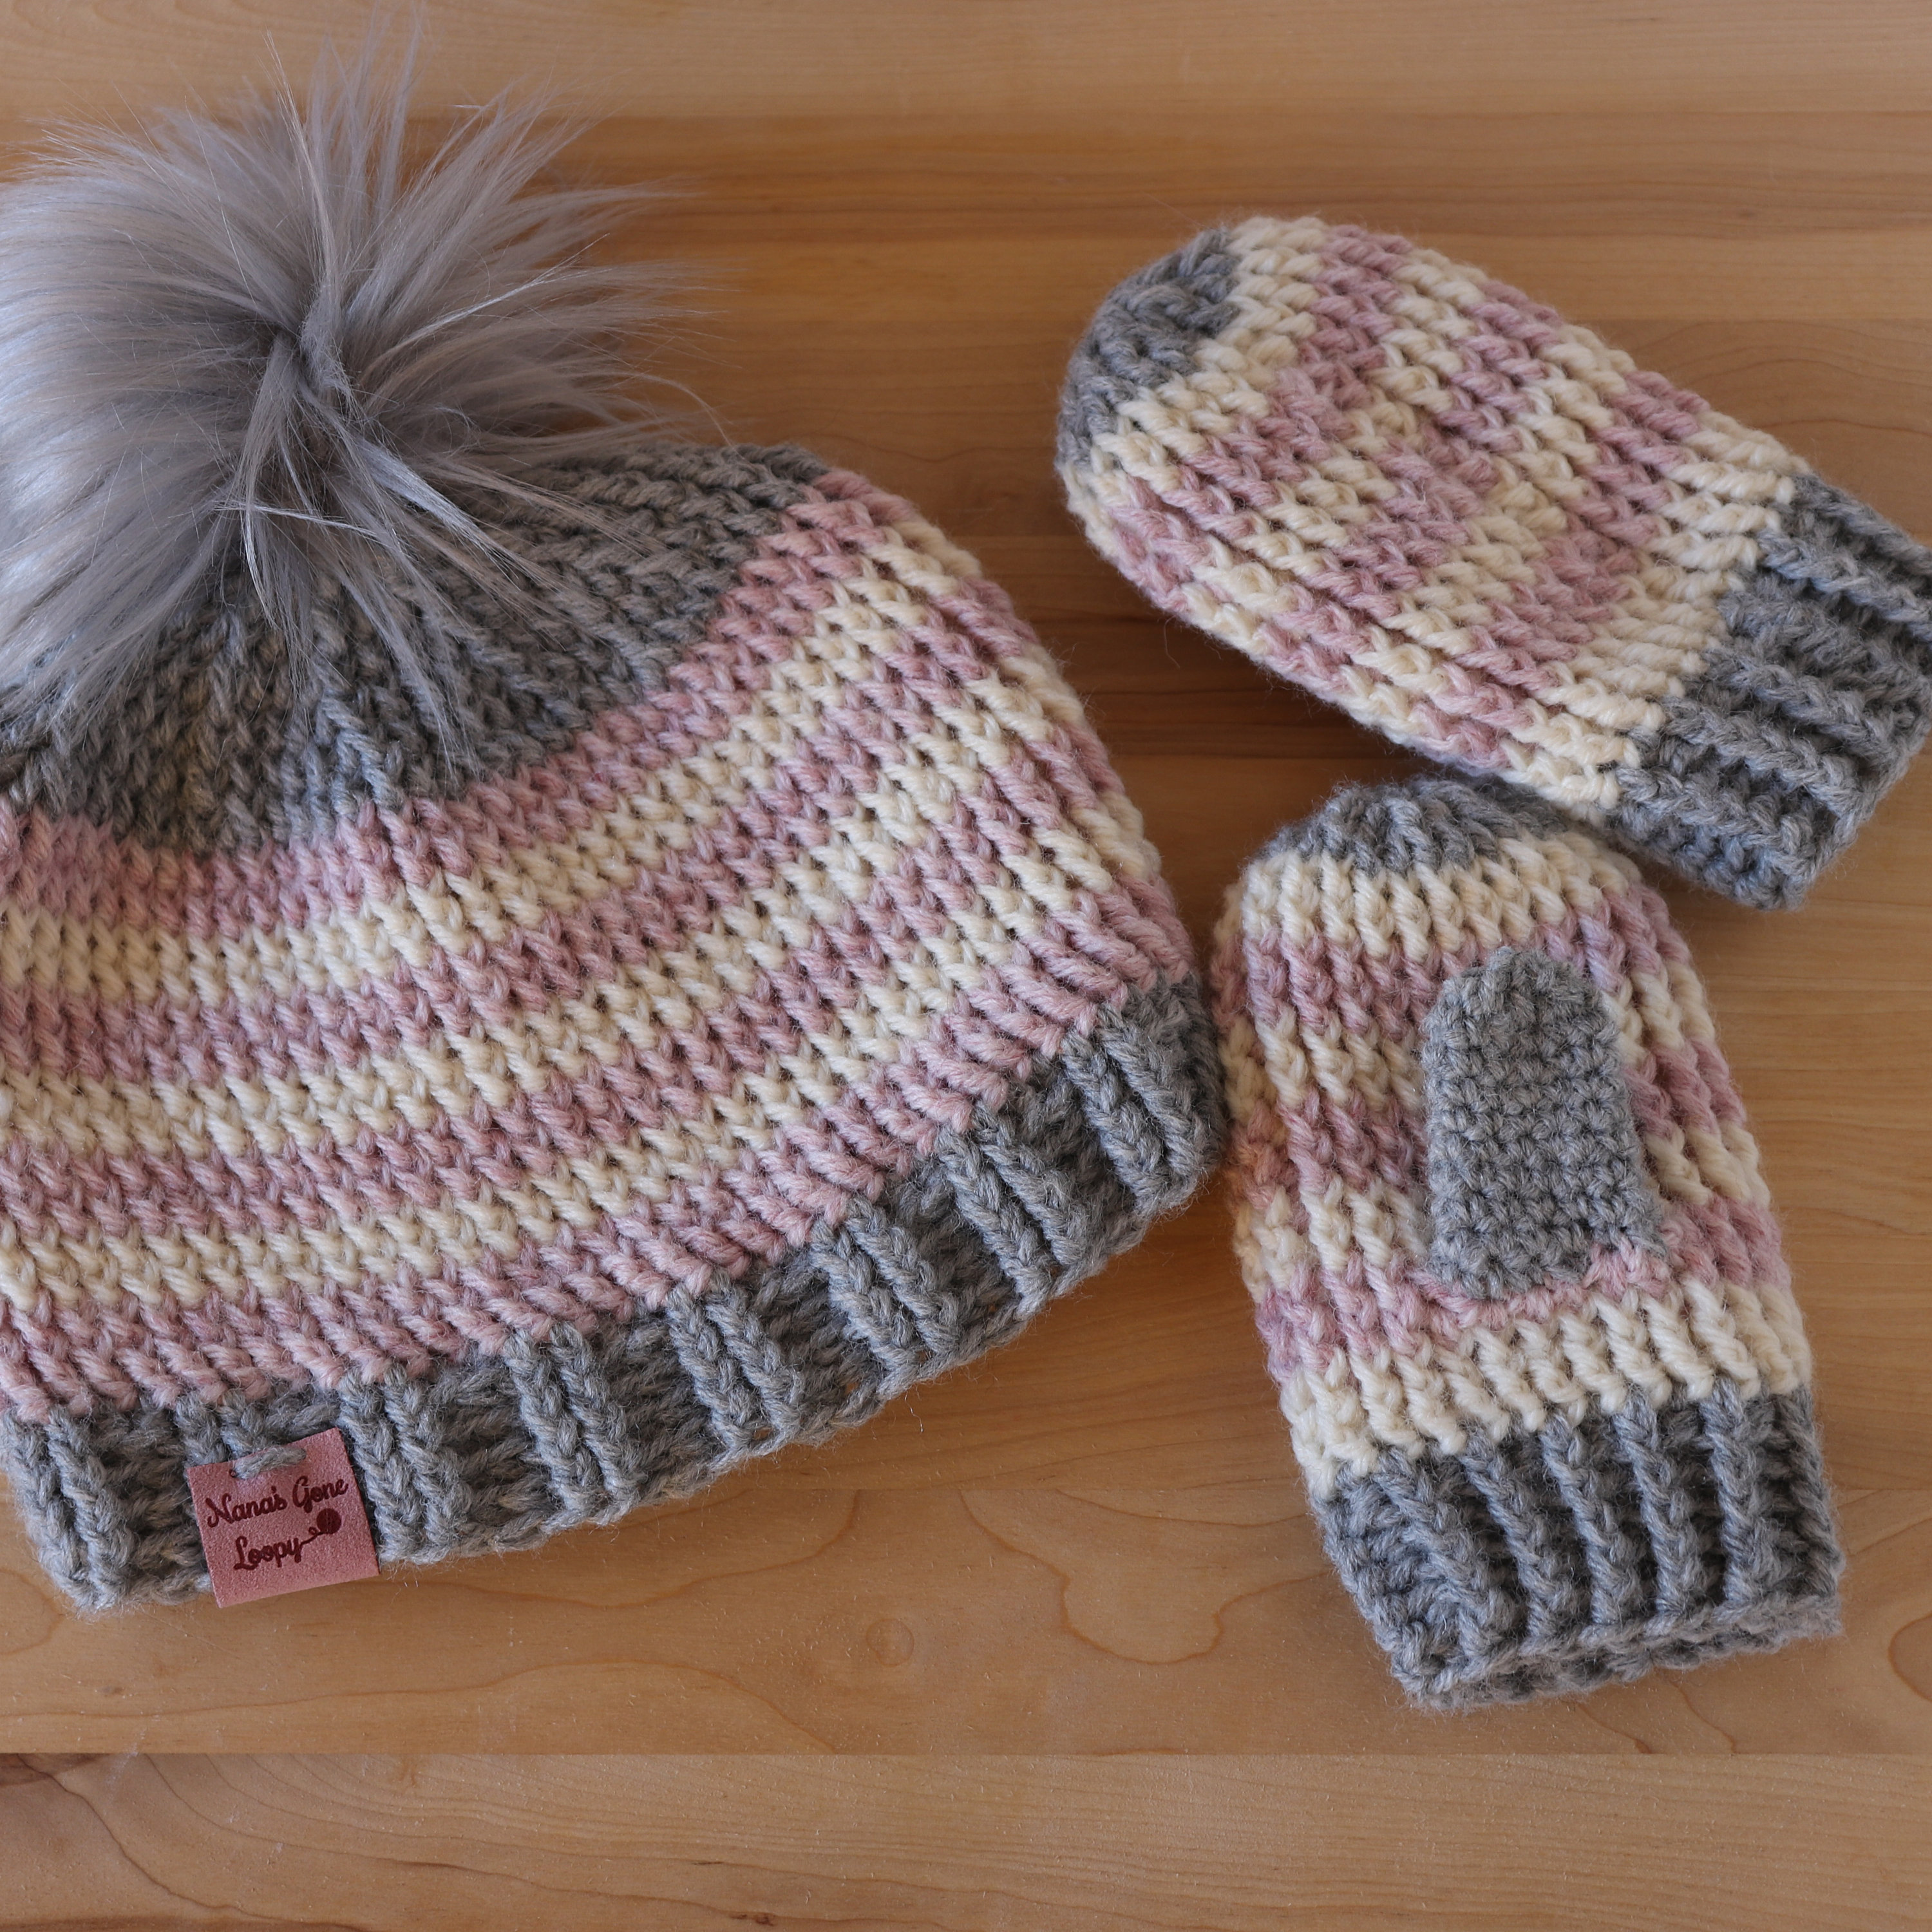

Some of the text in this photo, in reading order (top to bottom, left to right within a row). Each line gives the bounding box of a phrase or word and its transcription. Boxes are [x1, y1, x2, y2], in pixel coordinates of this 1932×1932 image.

[205, 1475, 349, 1528] Nana's Gone
[233, 1535, 307, 1570] Loopy
